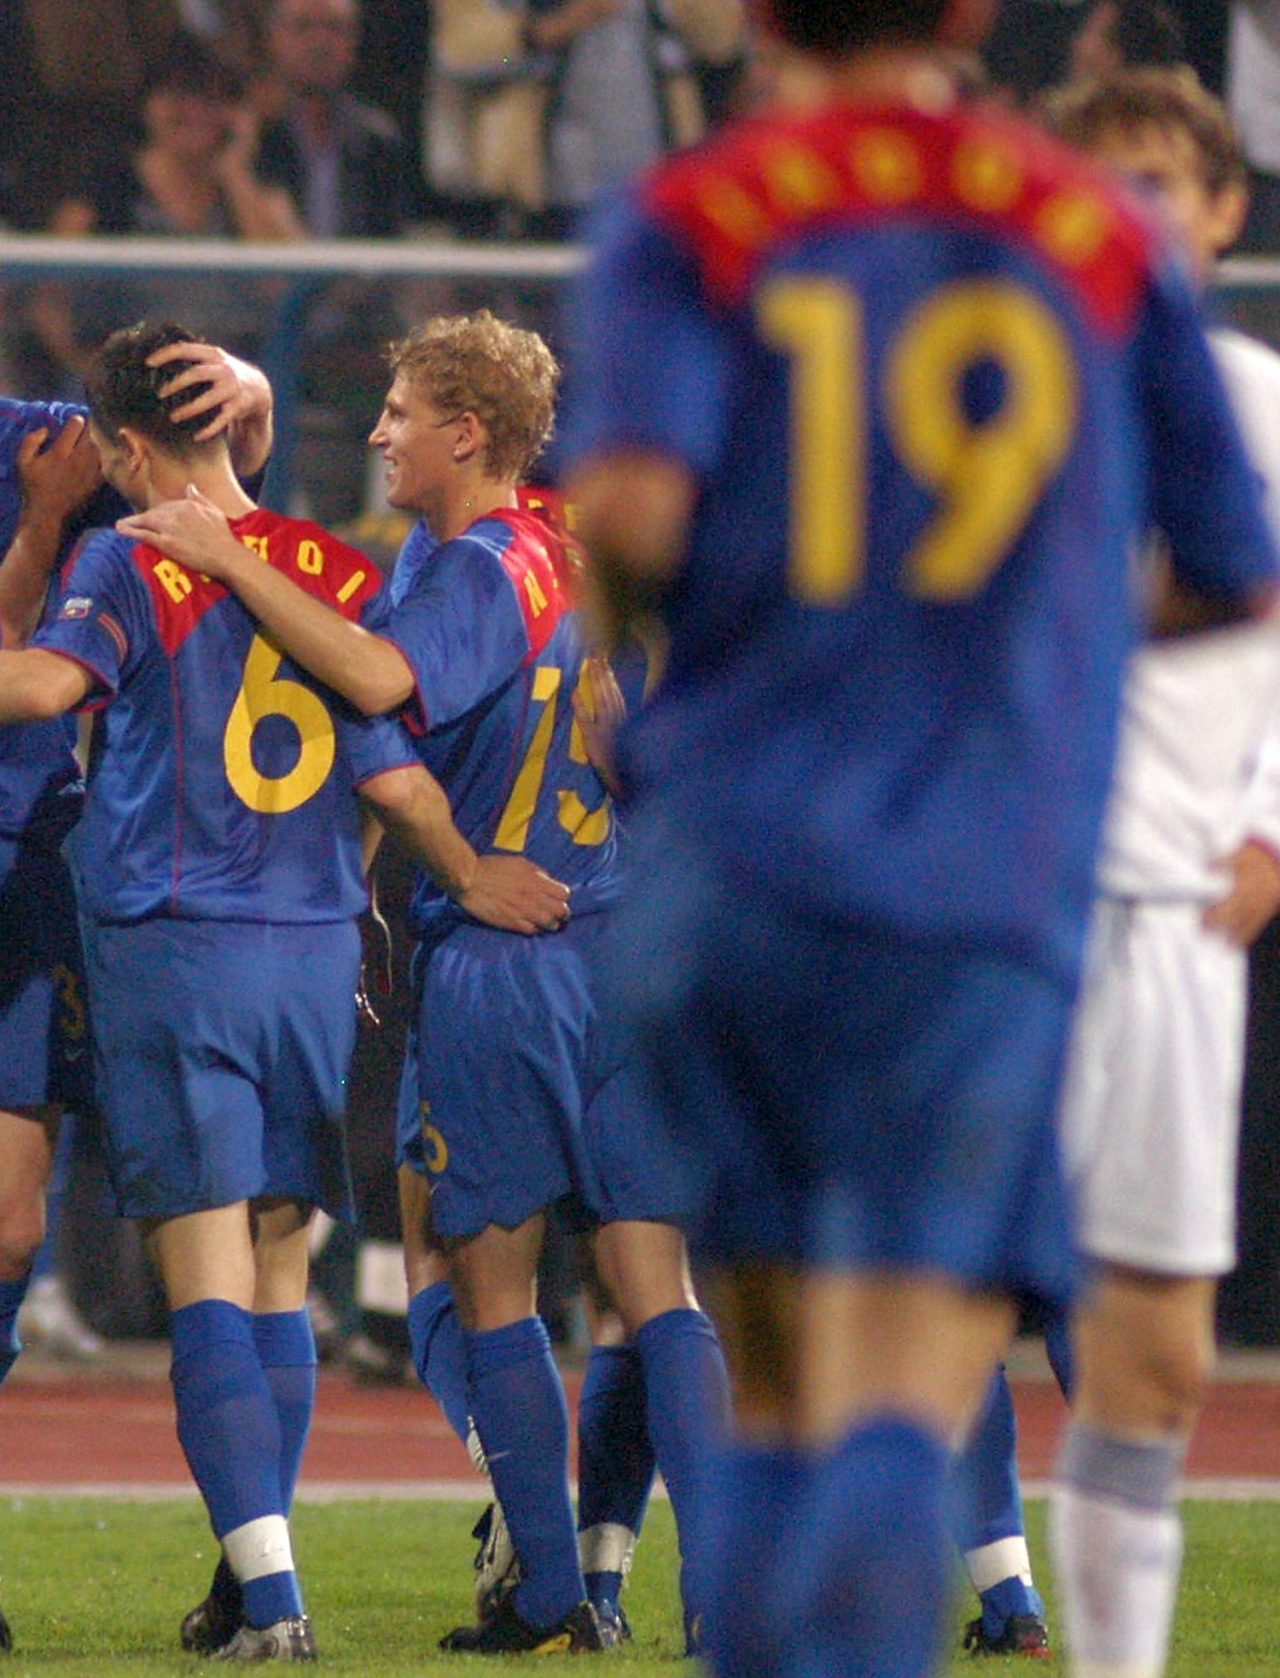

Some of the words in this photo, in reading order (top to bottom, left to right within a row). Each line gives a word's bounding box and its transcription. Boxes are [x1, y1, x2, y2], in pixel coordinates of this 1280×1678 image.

[754, 272, 1077, 606] 19
[152, 534, 367, 605] ROI
[223, 632, 336, 814] 6
